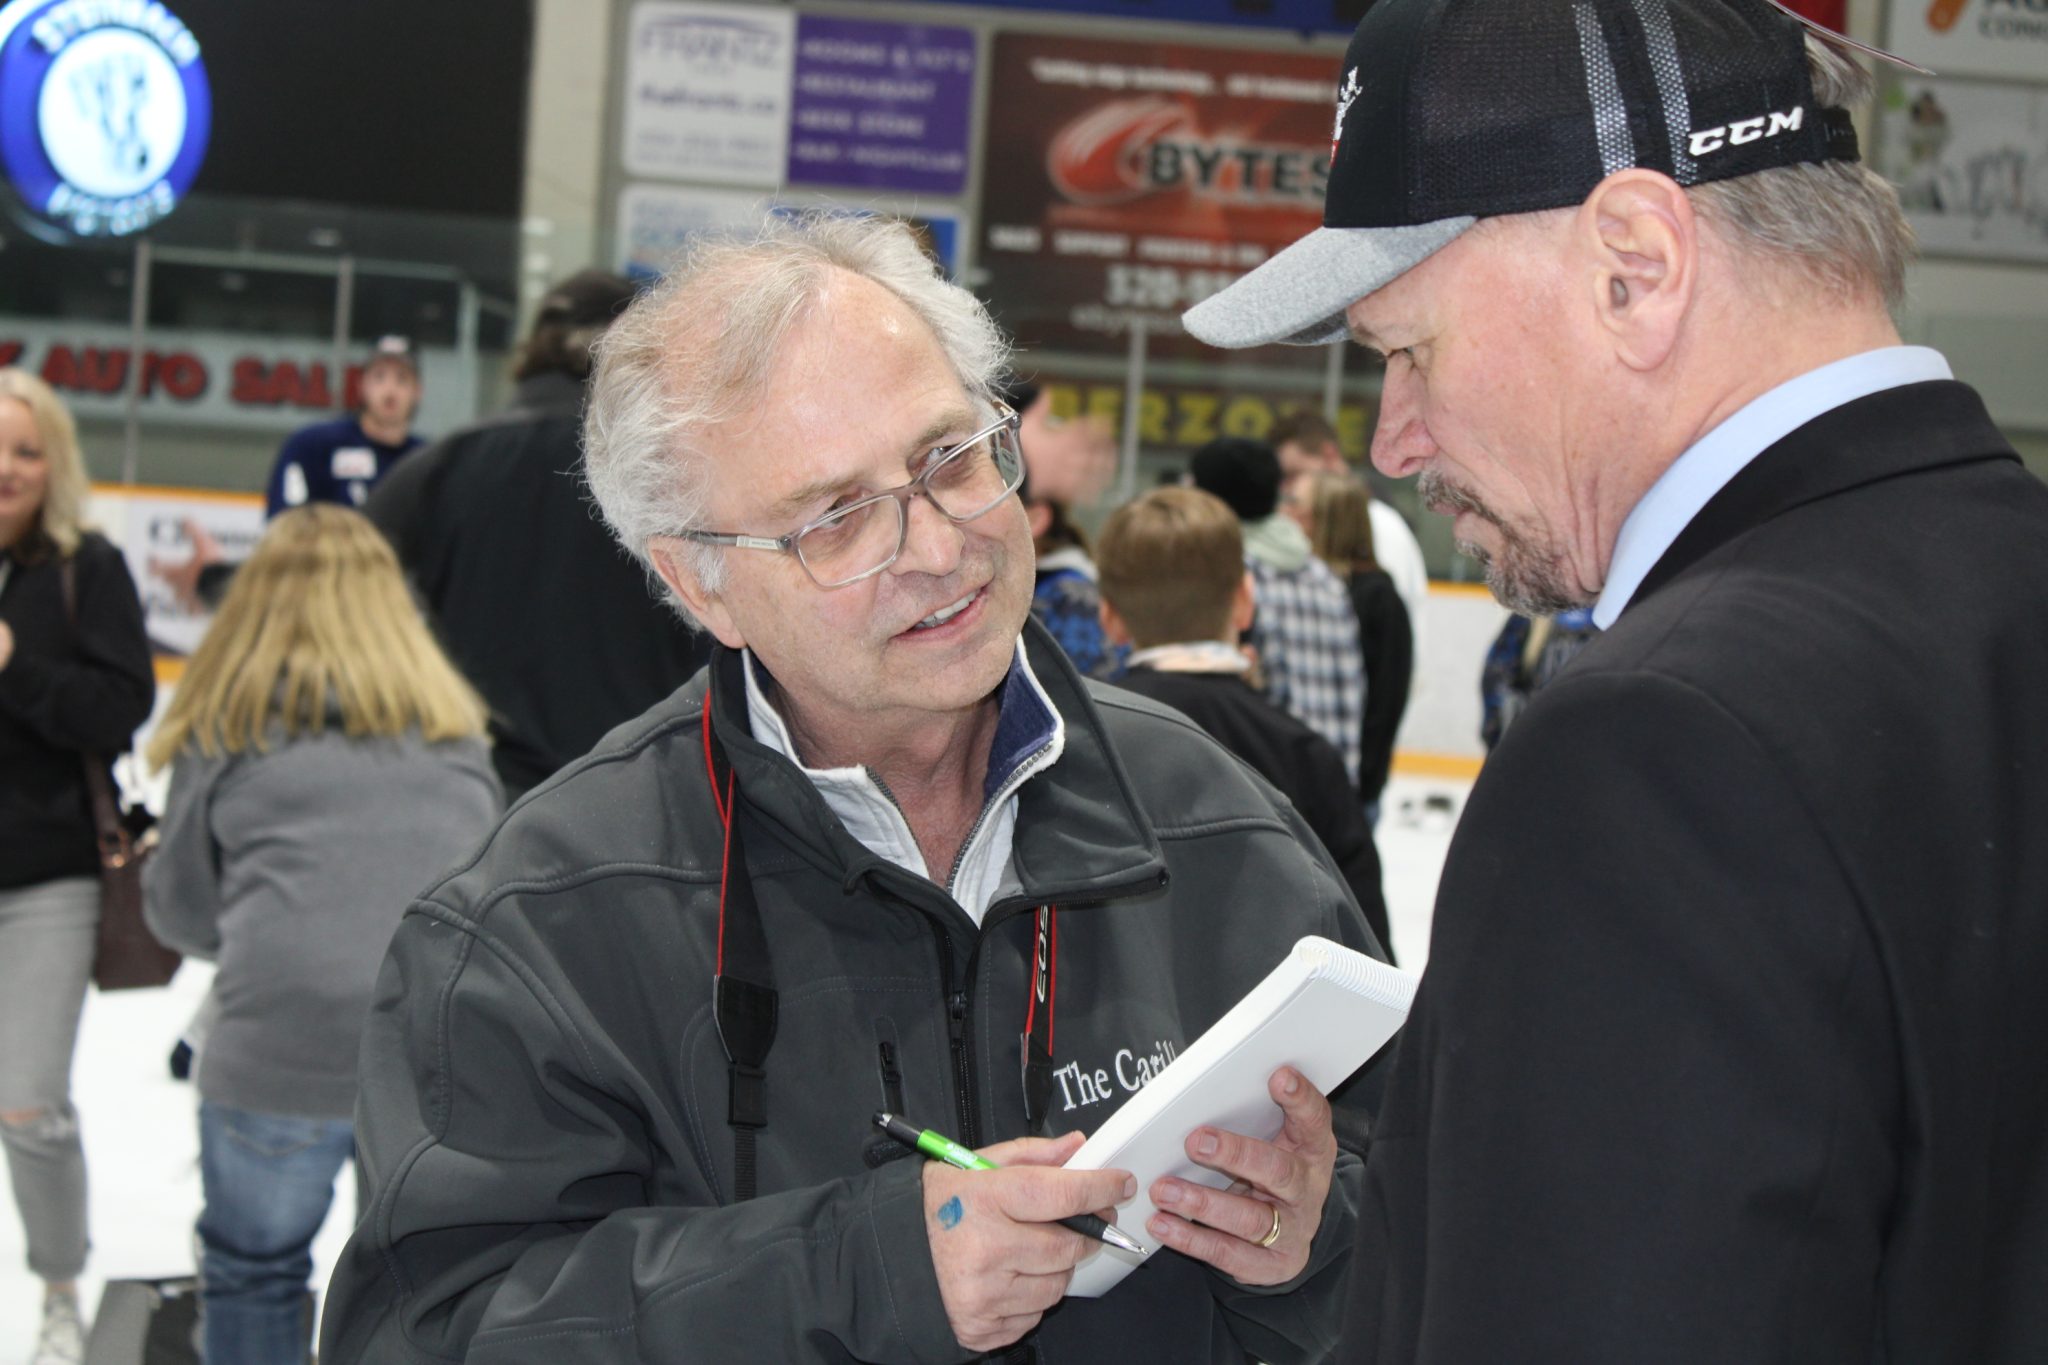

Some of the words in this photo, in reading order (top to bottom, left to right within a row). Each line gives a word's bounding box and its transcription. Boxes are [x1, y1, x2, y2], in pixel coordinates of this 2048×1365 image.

[1688, 106, 1803, 156] CCM
[1150, 142, 1333, 199] BYTES
[42, 343, 208, 401] AUTO
[1036, 904, 1049, 1004] EOS
[1053, 1060, 1113, 1111] The
